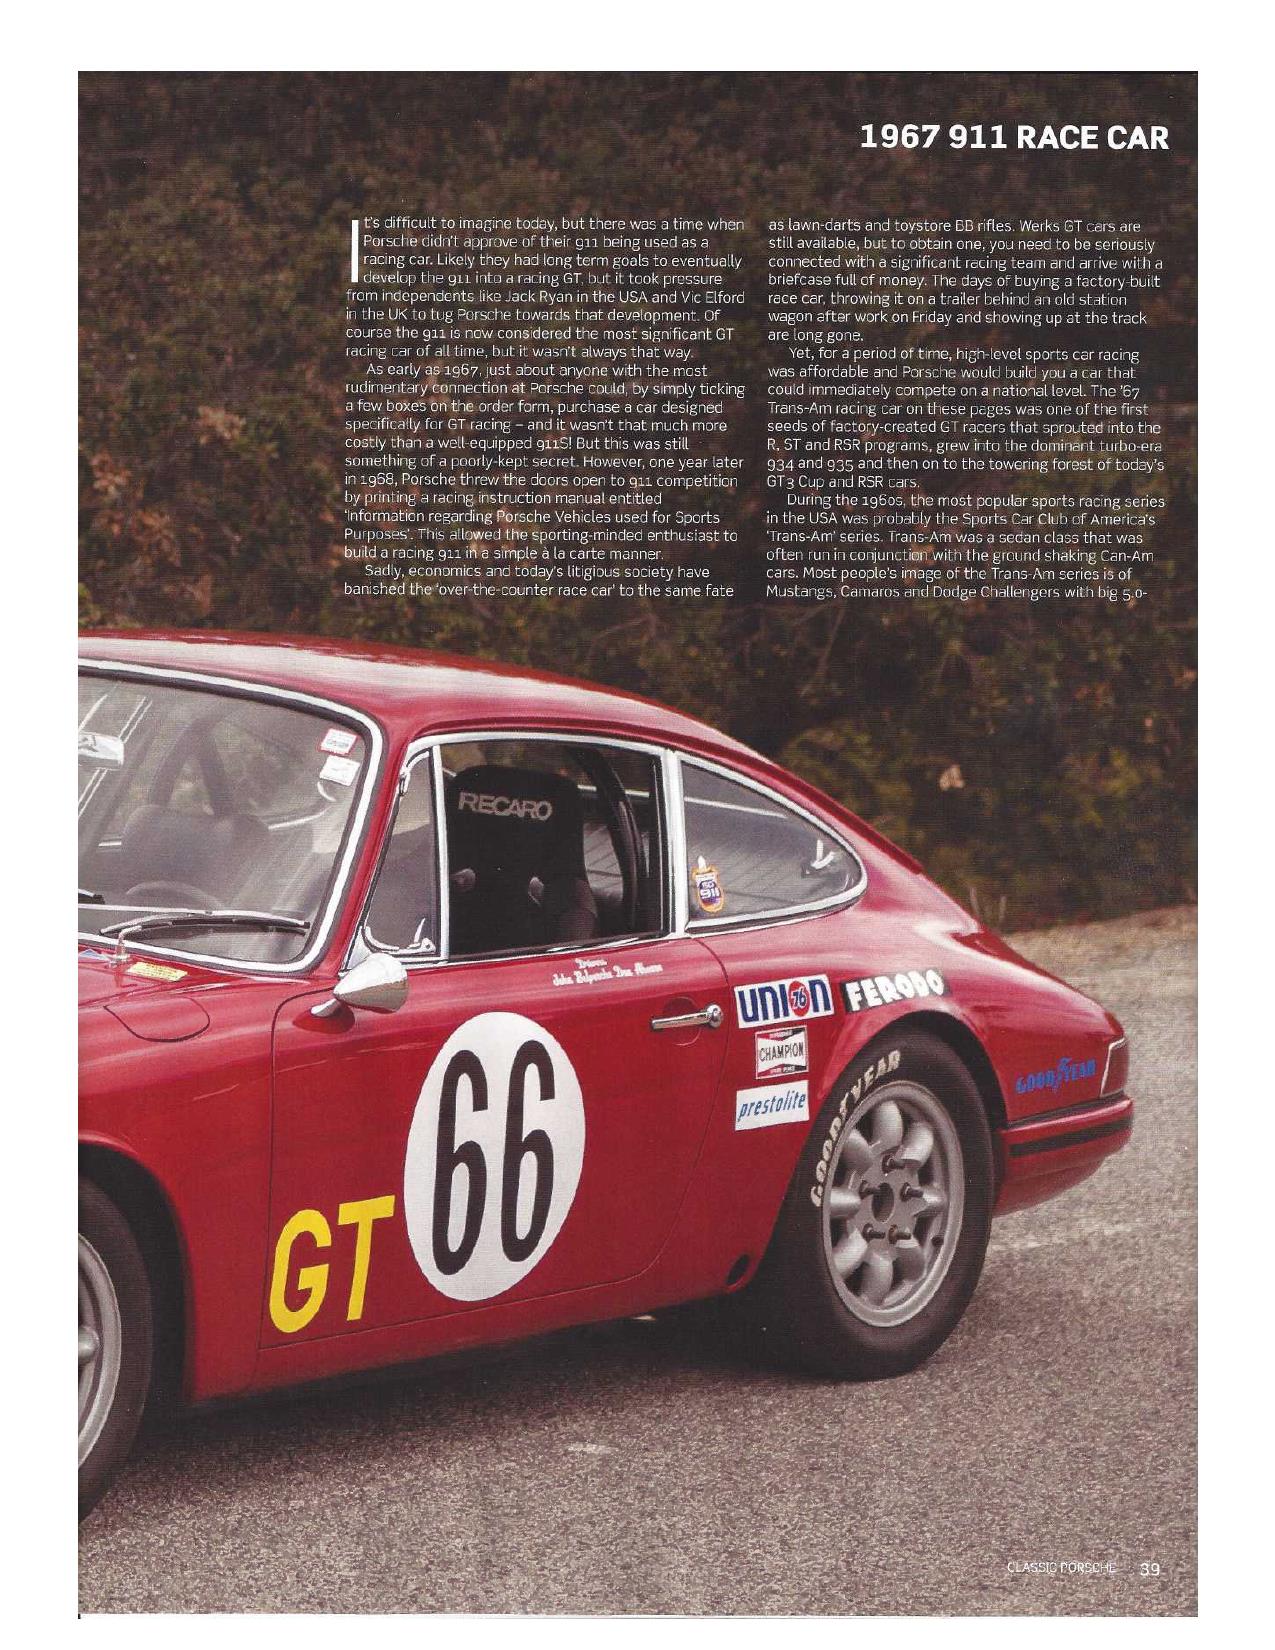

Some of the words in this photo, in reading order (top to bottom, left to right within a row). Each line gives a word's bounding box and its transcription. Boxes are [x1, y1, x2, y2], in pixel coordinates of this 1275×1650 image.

[861, 124, 940, 149] 1967
[949, 124, 1007, 149] 911
[1017, 125, 1099, 149] RACE
[1107, 125, 1169, 150] CAR
[363, 252, 405, 269] racing
[408, 256, 433, 266] car.
[437, 252, 474, 269] Likely
[479, 252, 510, 269] they
[514, 252, 539, 266] had
[543, 252, 572, 269] long
[575, 253, 608, 266] term
[612, 252, 649, 269] goals
[652, 253, 667, 266] to
[671, 252, 742, 269] eventually
[768, 254, 840, 268] connected
[844, 254, 874, 268] with
[890, 254, 961, 271] significant
[965, 254, 1006, 271] racing
[1010, 255, 1045, 268] team
[1049, 254, 1074, 268] and
[1079, 254, 1117, 268] arrive
[1121, 254, 1150, 268] with
[363, 271, 416, 288] develop
[420, 271, 443, 285] the
[447, 275, 471, 288] 911
[475, 271, 501, 285] into
[517, 271, 559, 288] racing
[563, 271, 583, 287] GT,
[588, 271, 611, 285] but
[615, 271, 624, 285] it
[628, 271, 659, 285] took
[663, 275, 722, 288] pressure
[767, 313, 812, 326] wagon
[816, 309, 850, 323] after
[854, 309, 888, 323] work
[889, 313, 908, 323] on
[912, 309, 952, 326] Friday
[956, 309, 981, 323] and
[984, 309, 1042, 326] showing
[1045, 313, 1062, 326] up
[1065, 310, 1080, 323] at
[1084, 309, 1108, 323] the
[1111, 309, 1147, 323] track
[345, 330, 391, 340] course
[395, 326, 418, 340] the
[422, 330, 446, 343] 911
[450, 326, 460, 340] is
[464, 330, 493, 340] now
[497, 326, 571, 340] considered
[575, 326, 598, 340] the
[603, 327, 637, 340] most
[641, 326, 712, 343] significant
[715, 326, 734, 340] GT
[767, 368, 795, 378] was
[799, 364, 871, 378] affordable
[869, 364, 897, 378] and
[902, 364, 956, 378] Porsche
[960, 364, 1000, 378] would
[1005, 364, 1036, 378] build
[1041, 368, 1065, 381] you
[1081, 368, 1102, 378] car
[1107, 364, 1136, 378] that
[345, 381, 428, 398] rudimentary
[431, 381, 507, 395] connection
[511, 382, 525, 395] at
[530, 381, 583, 395] Porsche
[588, 381, 627, 397] could,
[632, 381, 648, 398] by
[652, 381, 696, 398] simply
[699, 381, 745, 398] ticking
[767, 419, 807, 433] seeds
[811, 419, 826, 433] of
[830, 419, 936, 436] factory-created
[940, 419, 958, 433] GT
[962, 423, 1005, 433] racers
[1009, 419, 1038, 433] that
[1042, 419, 1103, 436] sprouted
[1107, 419, 1133, 433] into
[1137, 419, 1161, 433] the
[344, 436, 386, 453] costly
[390, 436, 421, 450] than
[437, 436, 532, 453] well-equipped
[536, 436, 571, 453] 911S!
[576, 436, 601, 450] But
[603, 436, 628, 450] this
[633, 440, 660, 450] was
[664, 436, 689, 450] still
[766, 474, 794, 491] GT3
[798, 474, 824, 491] Cup
[828, 474, 853, 488] and
[857, 474, 883, 488] RSR
[888, 478, 919, 488] cars.
[344, 491, 360, 508] by
[364, 491, 416, 508] printing
[433, 491, 474, 508] racing
[478, 491, 551, 505] instruction
[555, 491, 605, 505] manual
[608, 491, 661, 505] entitled
[344, 546, 376, 560] build
[392, 546, 434, 563] racing
[438, 550, 461, 563] 911
[465, 546, 477, 560] in
[493, 546, 537, 563] simple
[553, 546, 565, 560] la
[569, 547, 605, 560] carte
[609, 550, 663, 560] manner.
[766, 548, 803, 562] often
[808, 552, 830, 562] run
[833, 548, 845, 562] in
[849, 548, 927, 565] conjunction
[932, 548, 961, 562] with
[965, 548, 989, 562] the
[992, 548, 1040, 565] ground
[1044, 548, 1096, 565] shaking
[1100, 548, 1153, 562] Can-Am
[766, 584, 836, 601] Mustangs,
[838, 584, 899, 598] Camaros
[904, 584, 928, 598] and
[933, 584, 976, 601] Dodge
[980, 584, 1059, 601] Challengers
[1064, 584, 1093, 598] with
[1097, 584, 1117, 601] big
[1122, 588, 1147, 601] 5.0-
[458, 792, 553, 821] RECARO
[846, 970, 944, 1011] FERODO
[759, 1042, 804, 1061] CHAMPION
[737, 1089, 806, 1122] prestolite
[432, 1040, 555, 1275] 66
[269, 1195, 395, 1333] GT
[1007, 1562, 1057, 1574] CLASSIC
[1060, 1562, 1117, 1574] PORSCHE
[1139, 1563, 1161, 1577] 39
